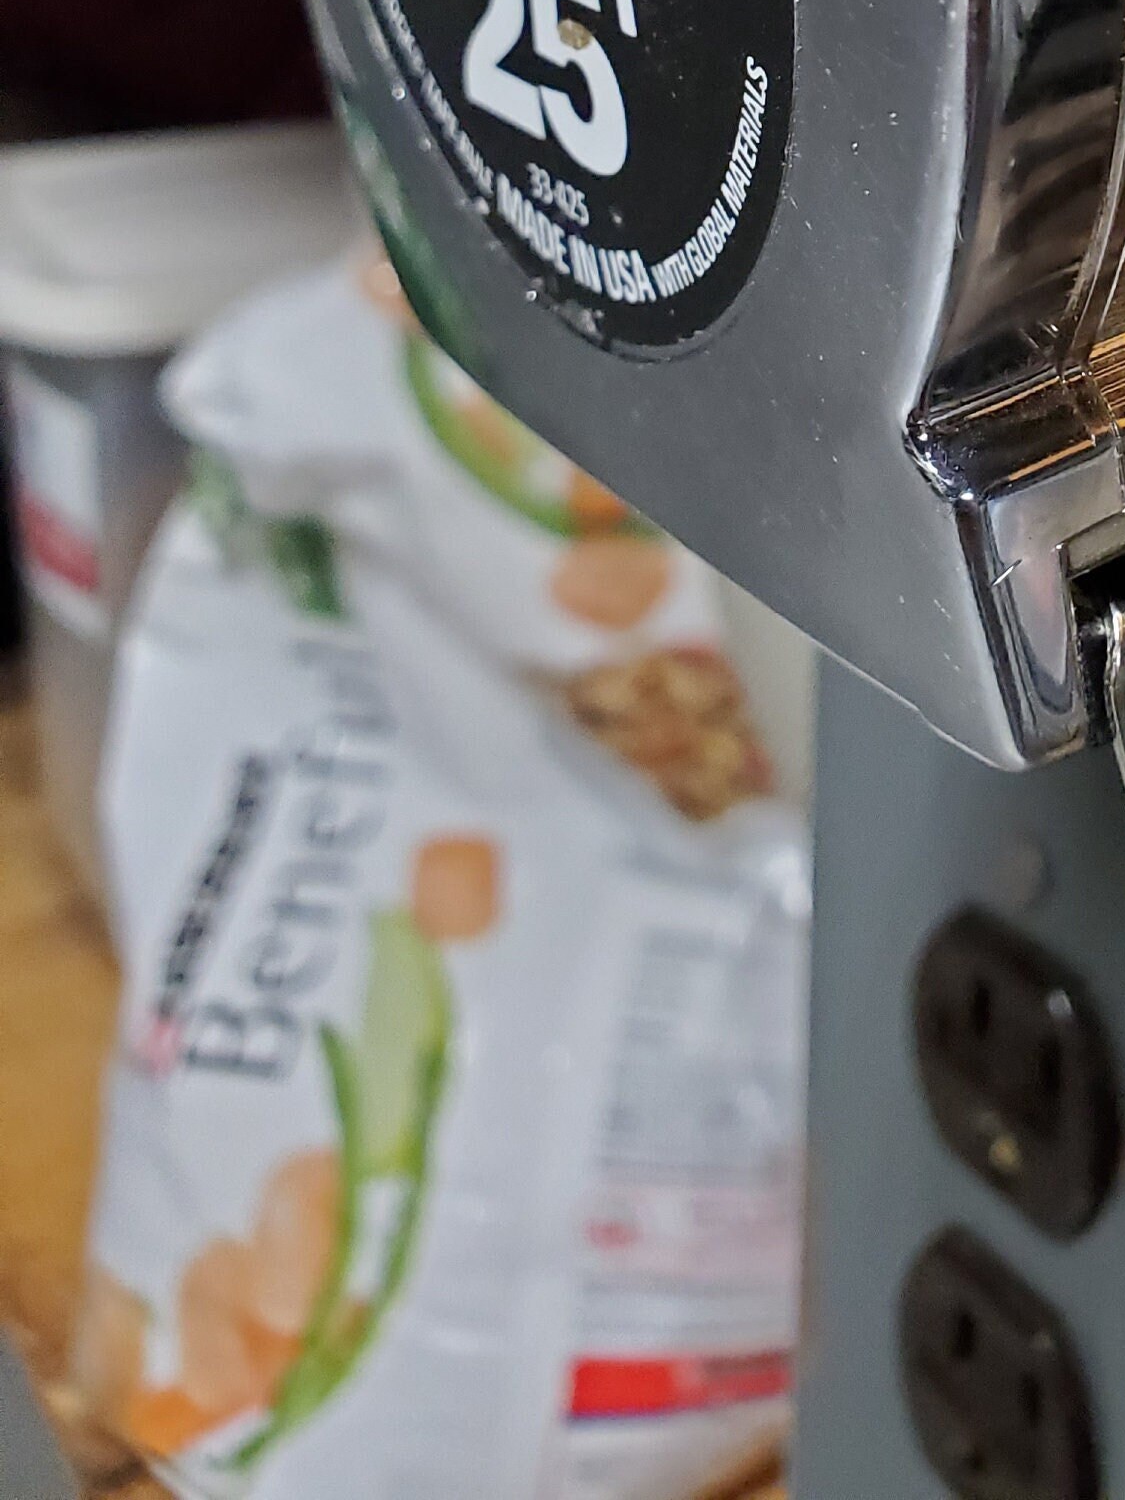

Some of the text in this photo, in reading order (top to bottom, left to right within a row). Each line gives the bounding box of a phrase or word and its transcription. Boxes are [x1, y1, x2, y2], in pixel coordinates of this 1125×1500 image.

[496, 56, 768, 304] MADE IN USA WITH GLOBAL MATERIALS
